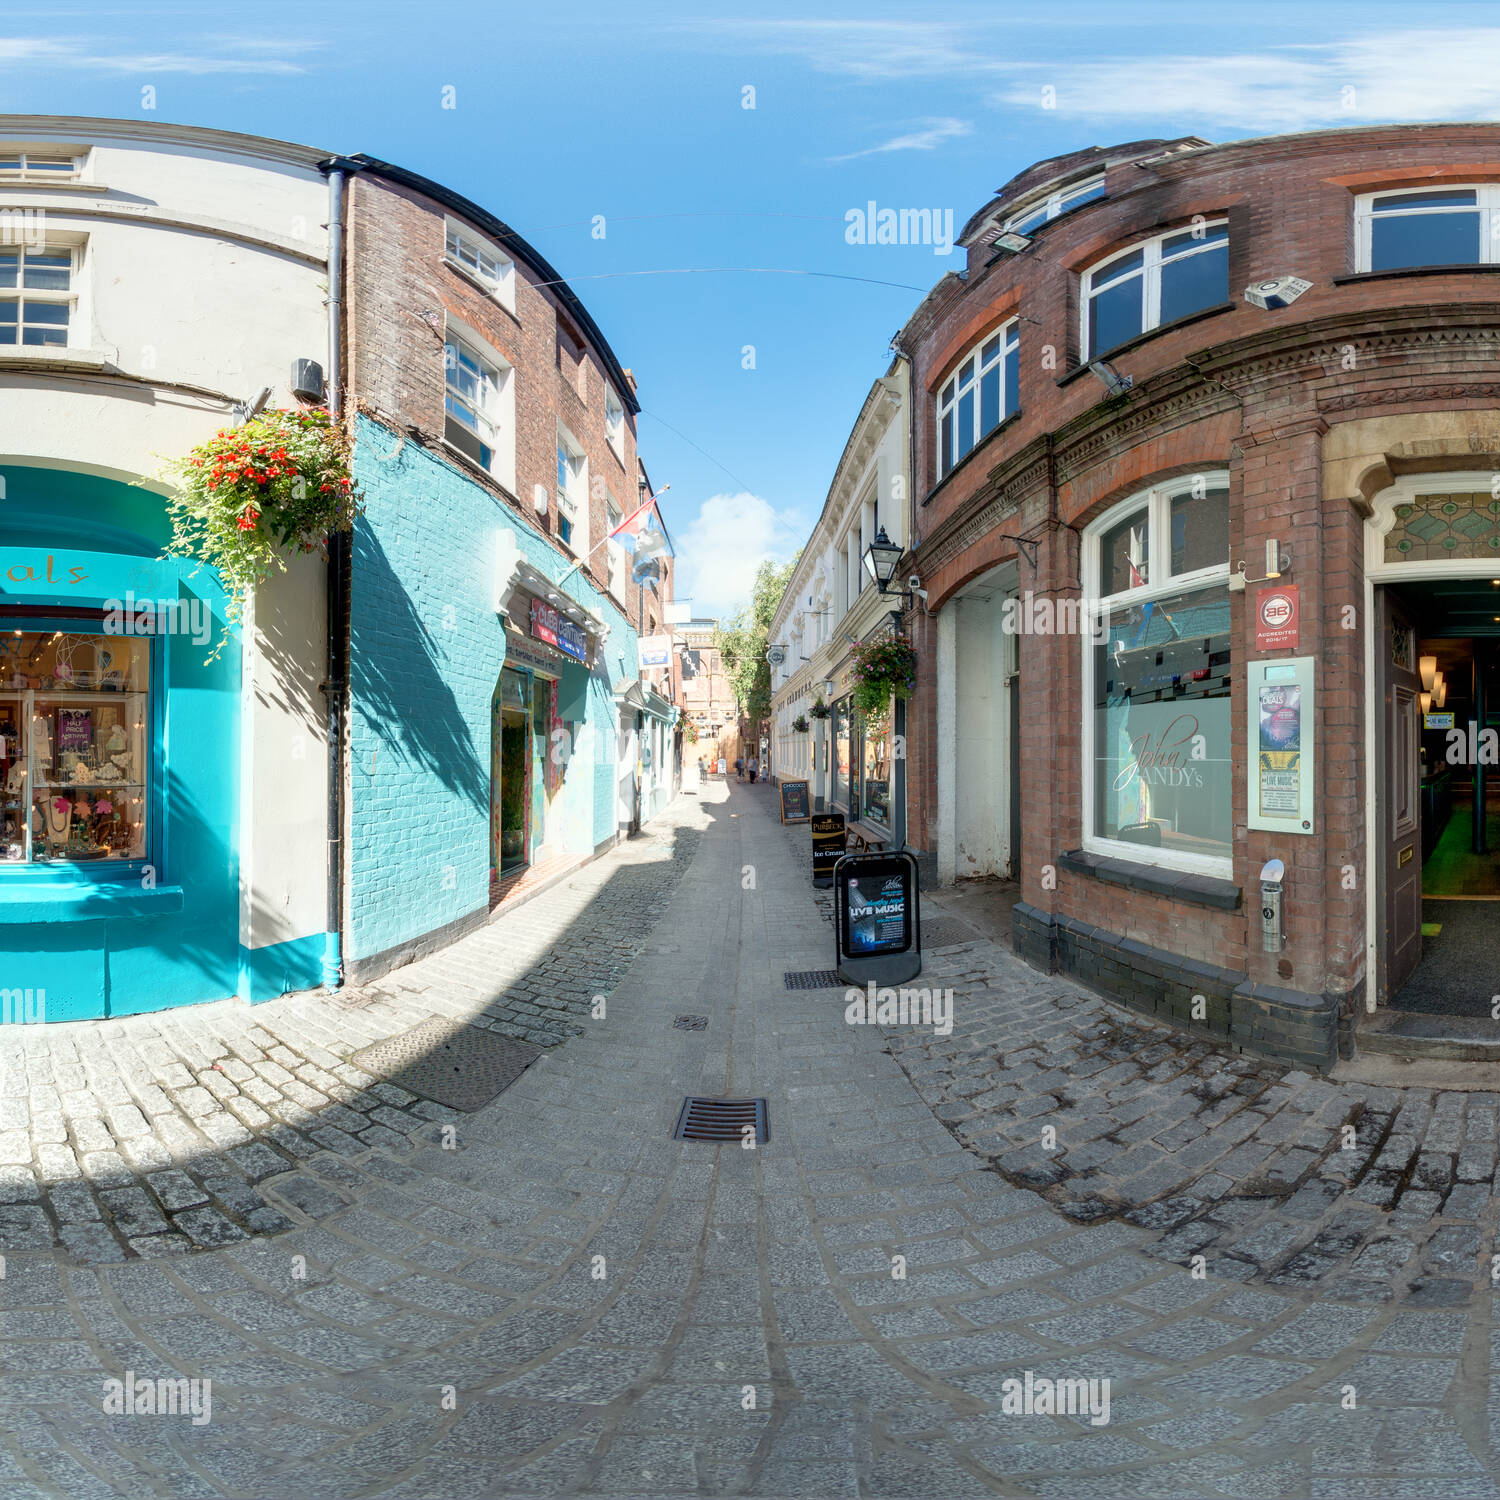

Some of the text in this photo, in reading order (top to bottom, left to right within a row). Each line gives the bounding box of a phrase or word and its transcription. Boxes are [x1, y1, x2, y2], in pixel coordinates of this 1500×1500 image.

[1113, 714, 1199, 791] John
[1137, 766, 1204, 788] ANDY's
[813, 823, 843, 832] PURBECK
[850, 904, 905, 917] LIVE MUSIC
